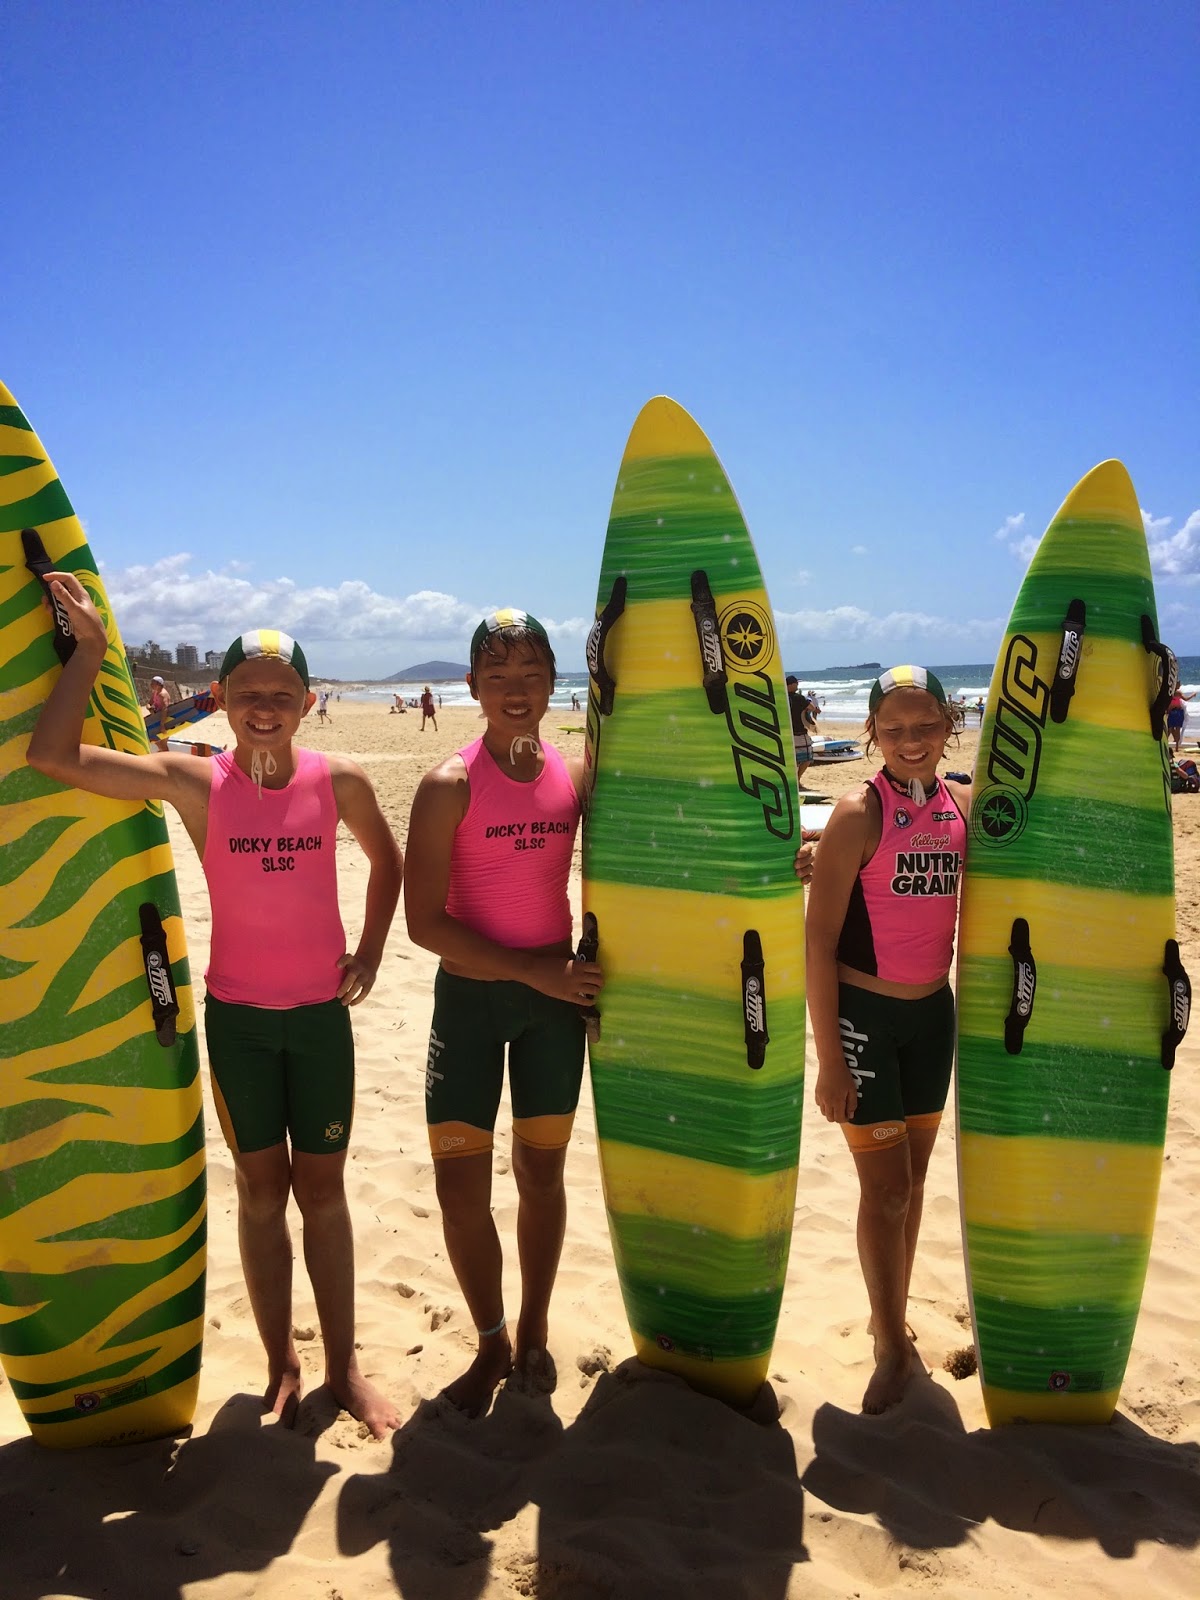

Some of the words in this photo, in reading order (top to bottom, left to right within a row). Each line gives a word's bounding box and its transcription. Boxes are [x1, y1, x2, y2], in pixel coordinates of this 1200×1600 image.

[485, 823, 527, 839] DICKY
[531, 821, 570, 835] BEACH
[229, 837, 272, 854] DICKY
[277, 836, 323, 853] BEACH
[514, 838, 546, 851] SLSC
[911, 832, 950, 850] Kellogg's
[262, 856, 295, 873] SLSC
[896, 851, 963, 875] NUTRI-
[891, 873, 958, 896] GRAIN
[839, 1014, 876, 1098] dick
